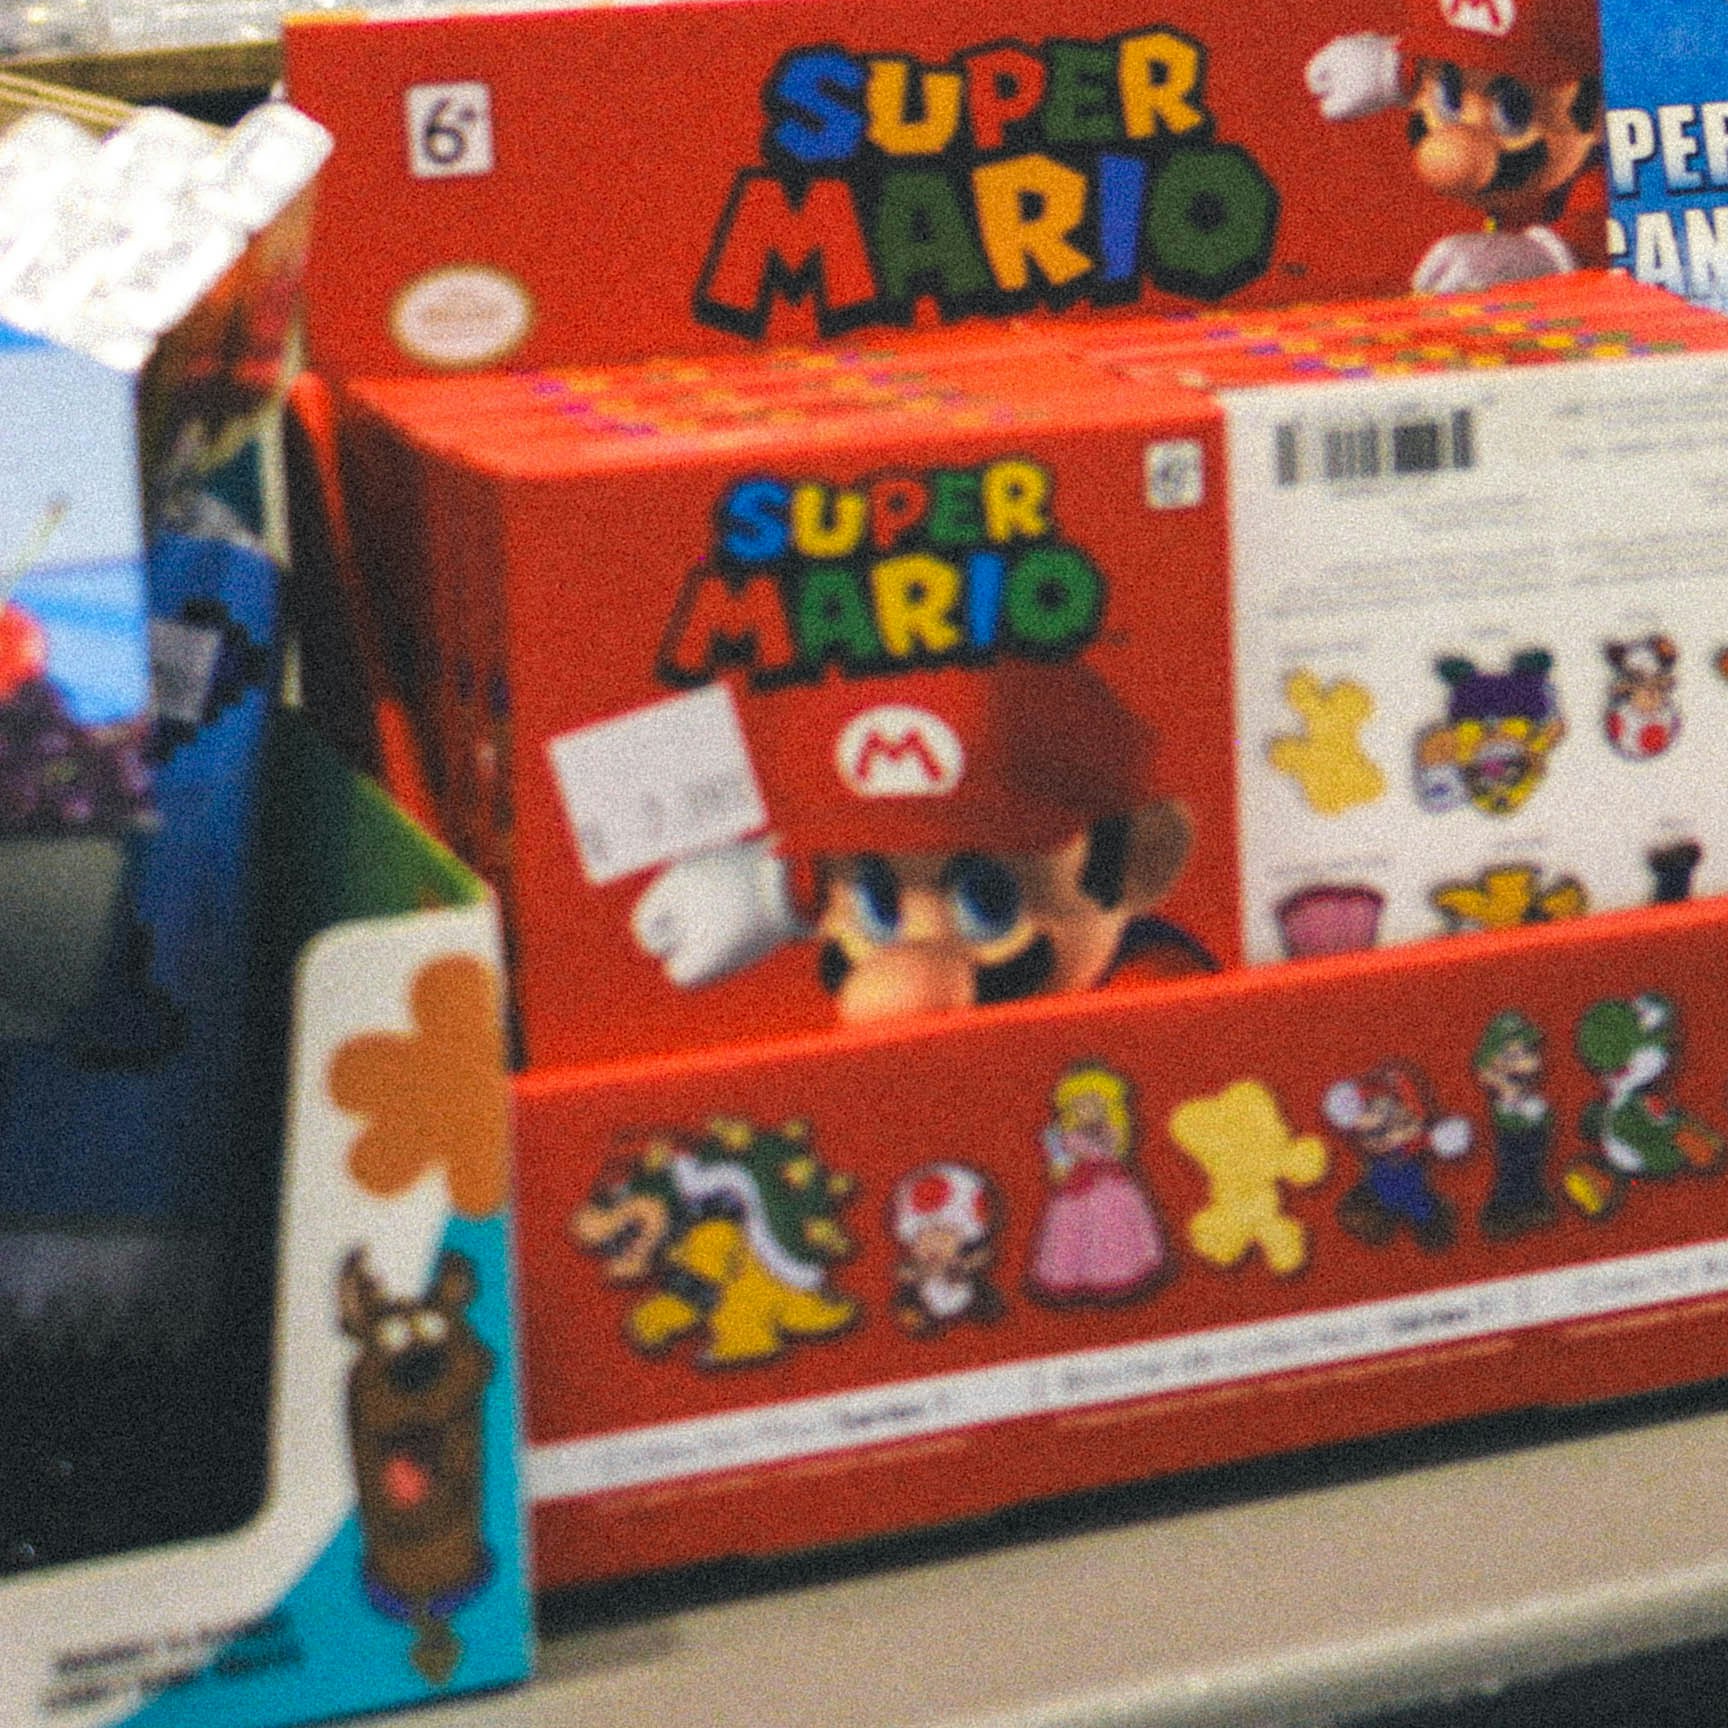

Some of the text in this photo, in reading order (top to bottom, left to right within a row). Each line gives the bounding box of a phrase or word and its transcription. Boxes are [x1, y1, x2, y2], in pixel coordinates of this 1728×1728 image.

[764, 27, 1210, 169] SUPER
[695, 142, 1283, 343] MARIO
[713, 458, 1057, 566] SUPER
[655, 536, 1108, 690] MARIO
